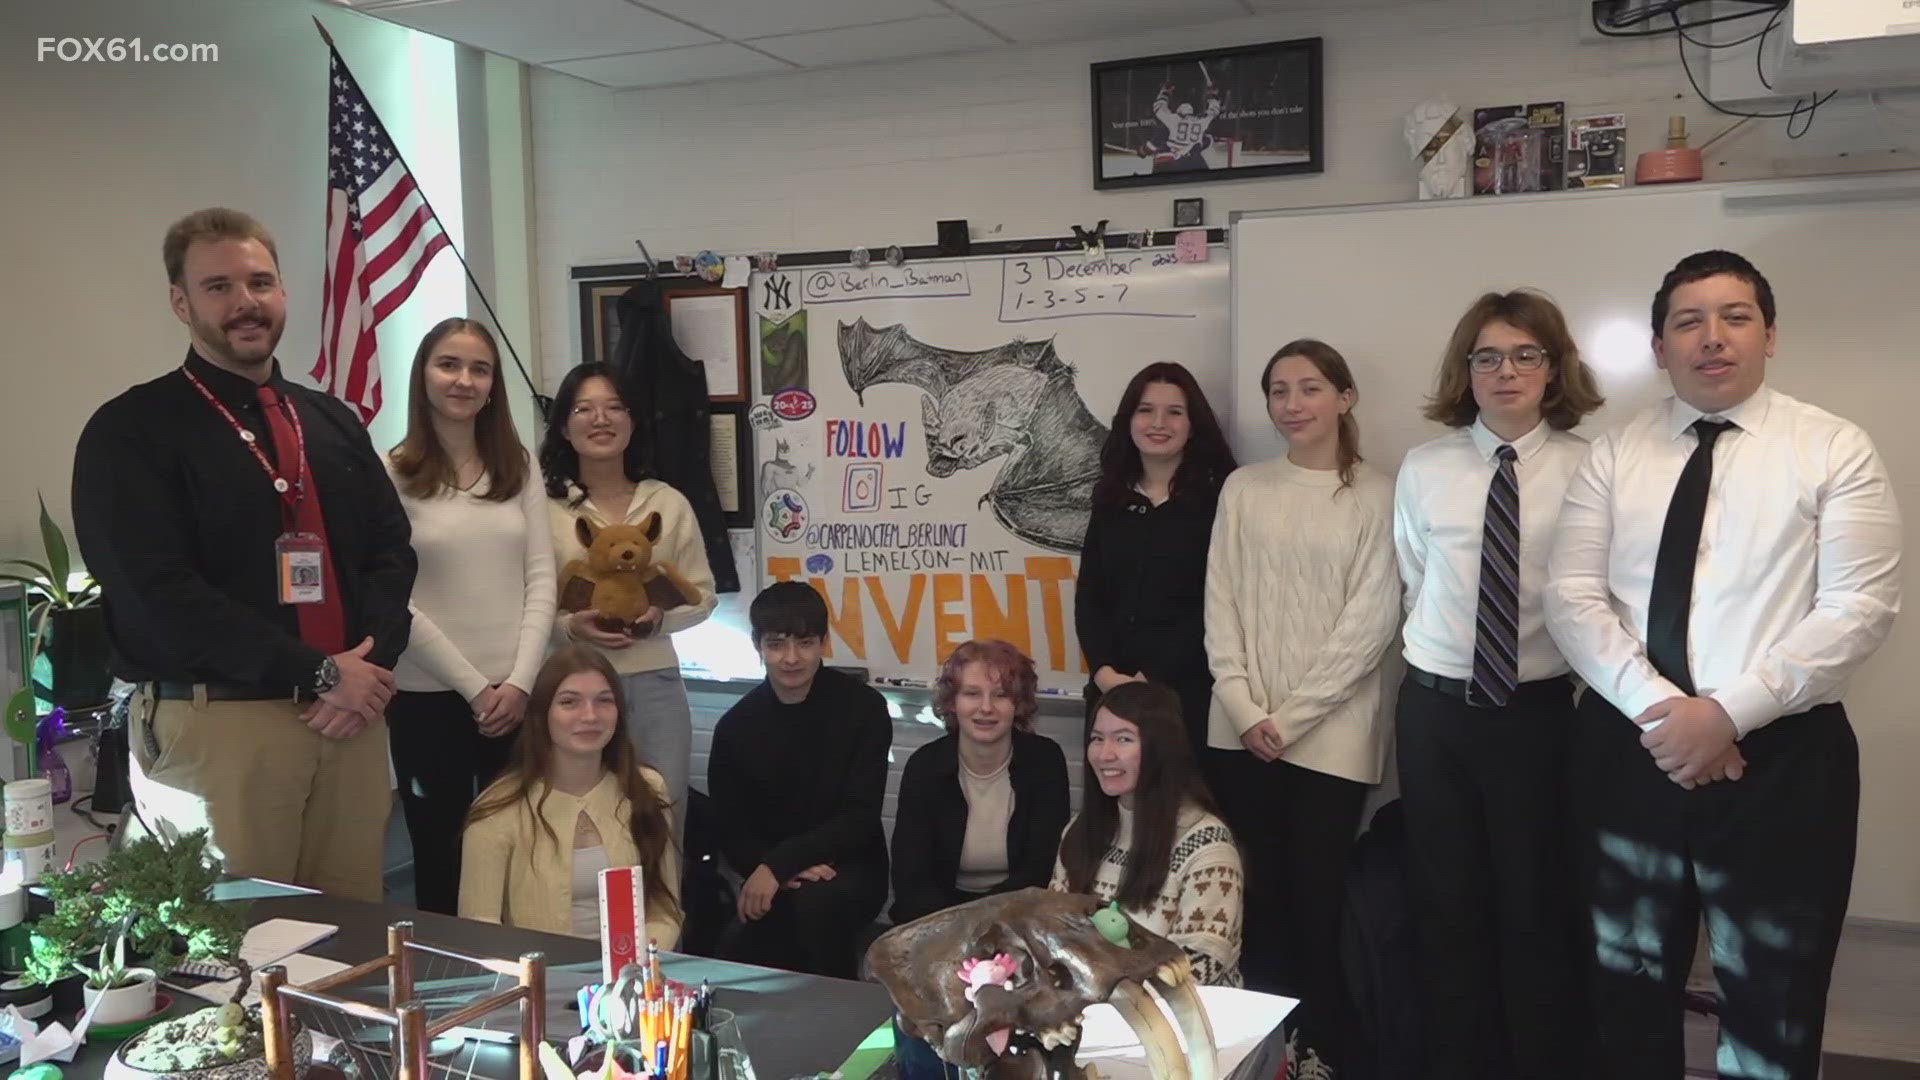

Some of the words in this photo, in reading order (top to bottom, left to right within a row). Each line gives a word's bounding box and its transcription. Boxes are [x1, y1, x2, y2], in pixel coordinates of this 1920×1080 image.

[1177, 122, 1202, 142] 99
[1015, 262, 1032, 284] 3
[1042, 256, 1142, 280] December
[826, 420, 905, 459] FOLLOW
